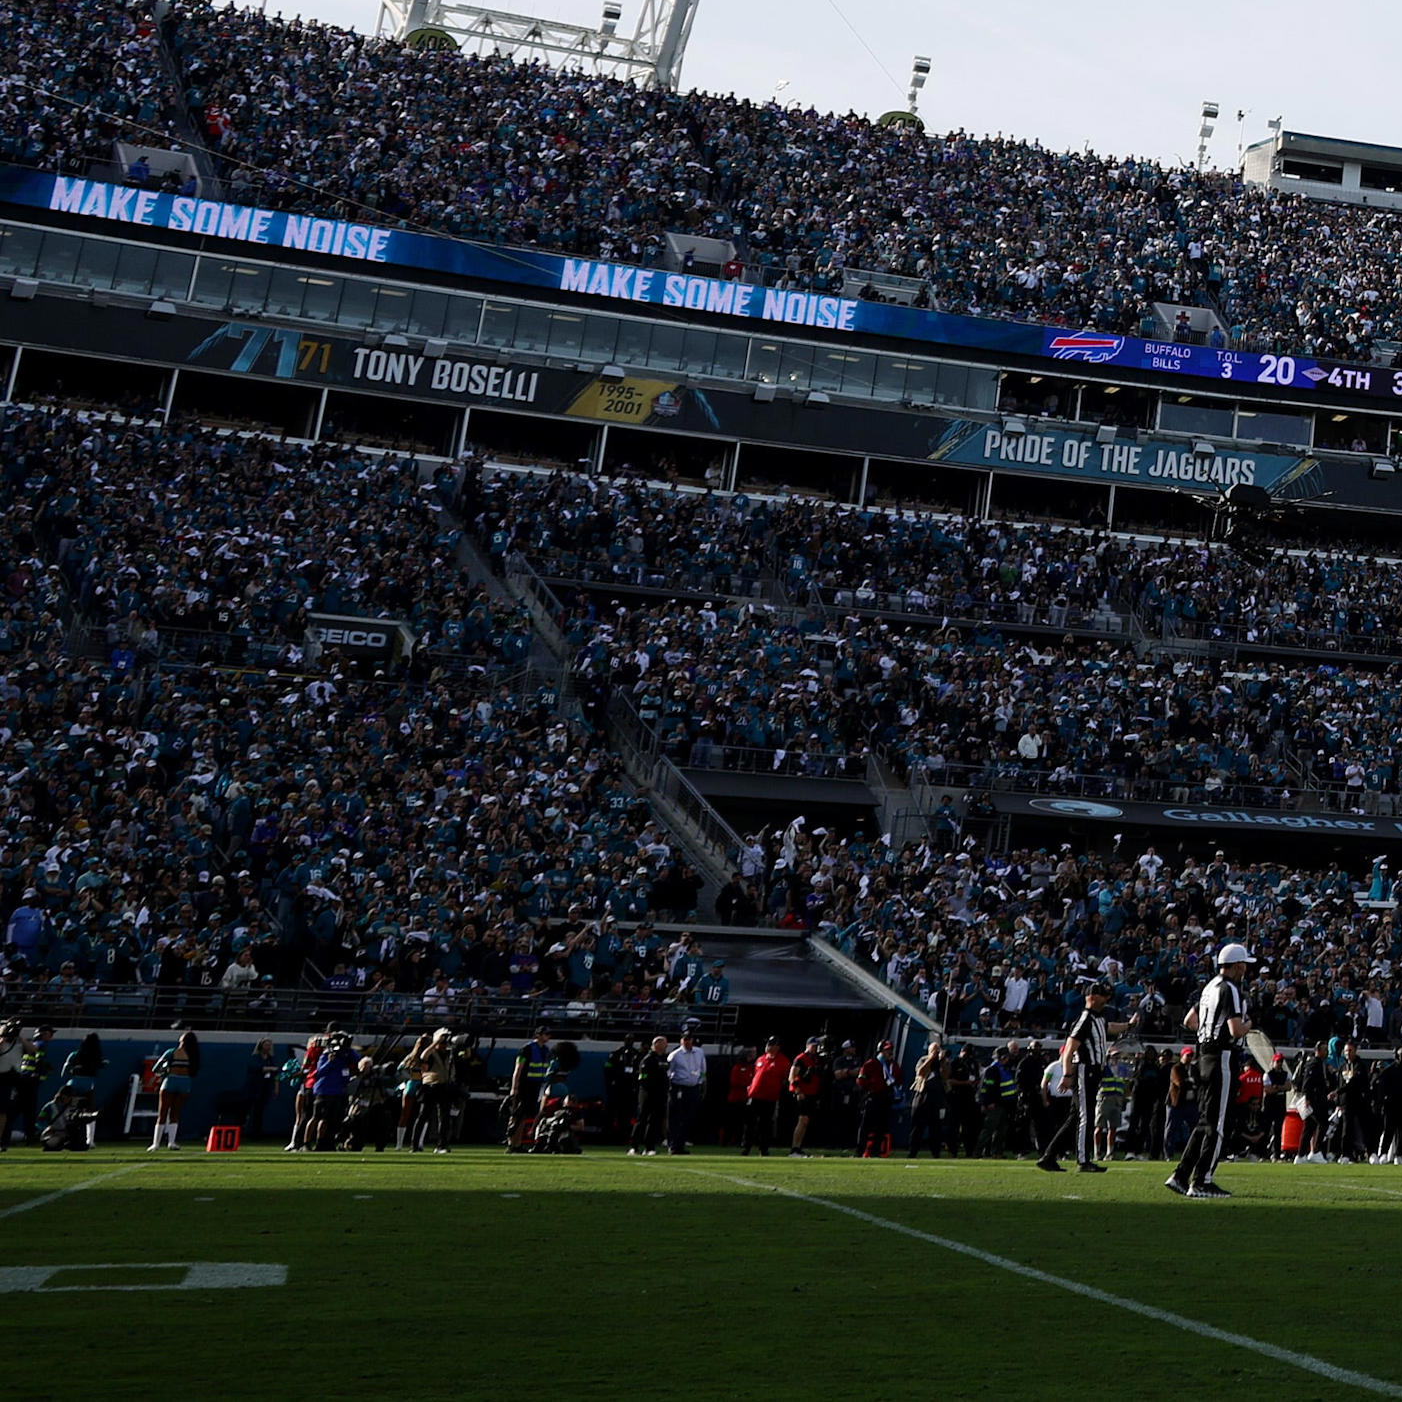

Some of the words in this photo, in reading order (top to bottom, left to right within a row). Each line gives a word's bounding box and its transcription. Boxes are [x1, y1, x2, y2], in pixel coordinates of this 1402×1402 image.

[49, 175, 159, 226] MAKE
[168, 197, 276, 245] SOME
[282, 214, 392, 263] NOISE
[560, 258, 655, 303] MAKE
[662, 273, 754, 317] SOME
[761, 289, 858, 331] NOISE
[1144, 343, 1191, 359] BUFFALO
[1216, 350, 1243, 364] T.O.L.
[299, 340, 332, 375] 71
[353, 347, 425, 386] TONY
[431, 358, 539, 403] BOSELLI
[1152, 357, 1181, 370] BILLS
[1221, 362, 1232, 379] 3
[1257, 354, 1295, 385] 20
[1327, 367, 1371, 391] 4TH
[600, 383, 643, 400] 1995-
[603, 399, 642, 416] 2001
[984, 429, 1055, 465] PRIDE
[1061, 438, 1093, 469] OF
[1100, 443, 1143, 475] THE
[1148, 449, 1256, 486] JAGUARS
[317, 628, 388, 647] GEICO
[1162, 808, 1376, 832] Gallagher
[707, 985, 721, 1001] 16
[215, 1129, 237, 1148] 10
